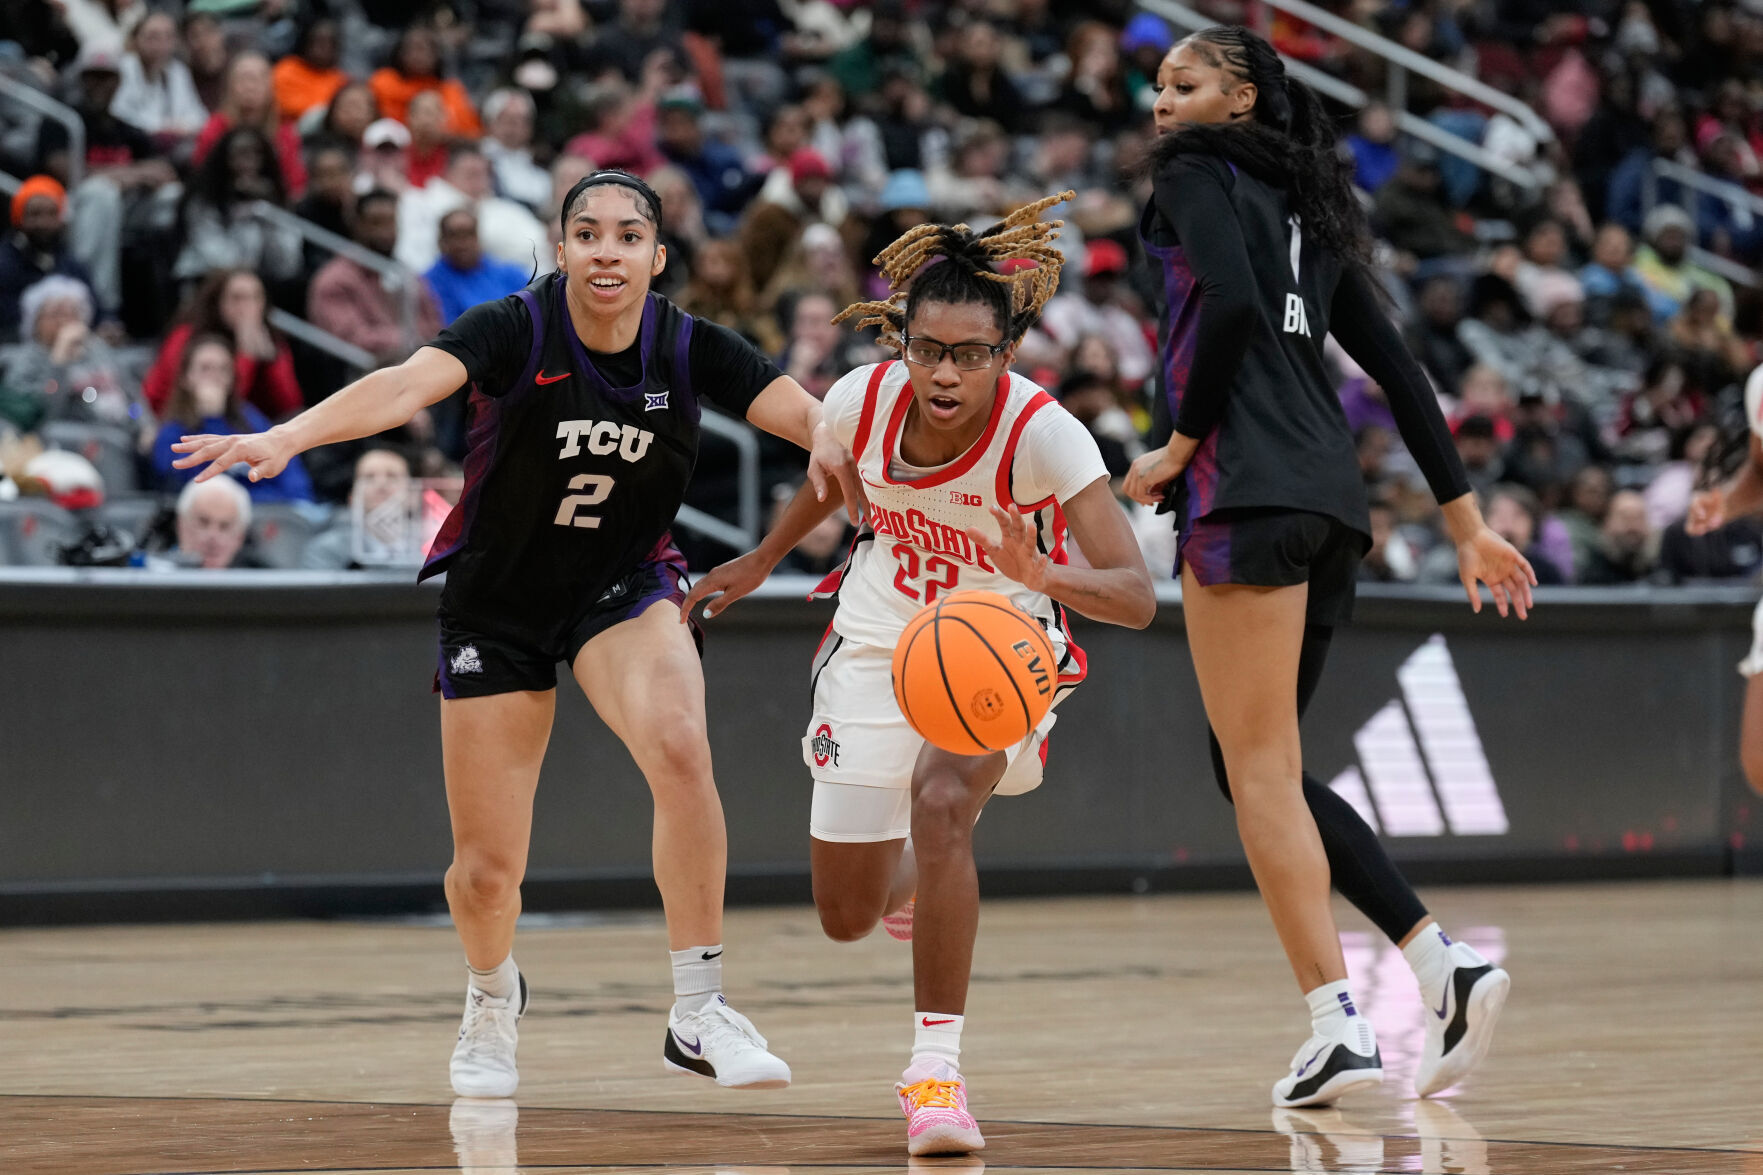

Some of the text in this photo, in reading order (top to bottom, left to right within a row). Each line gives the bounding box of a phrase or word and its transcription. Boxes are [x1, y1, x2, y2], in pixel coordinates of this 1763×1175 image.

[556, 419, 654, 463] TCU
[554, 473, 616, 529] 2
[891, 543, 959, 606] 22
